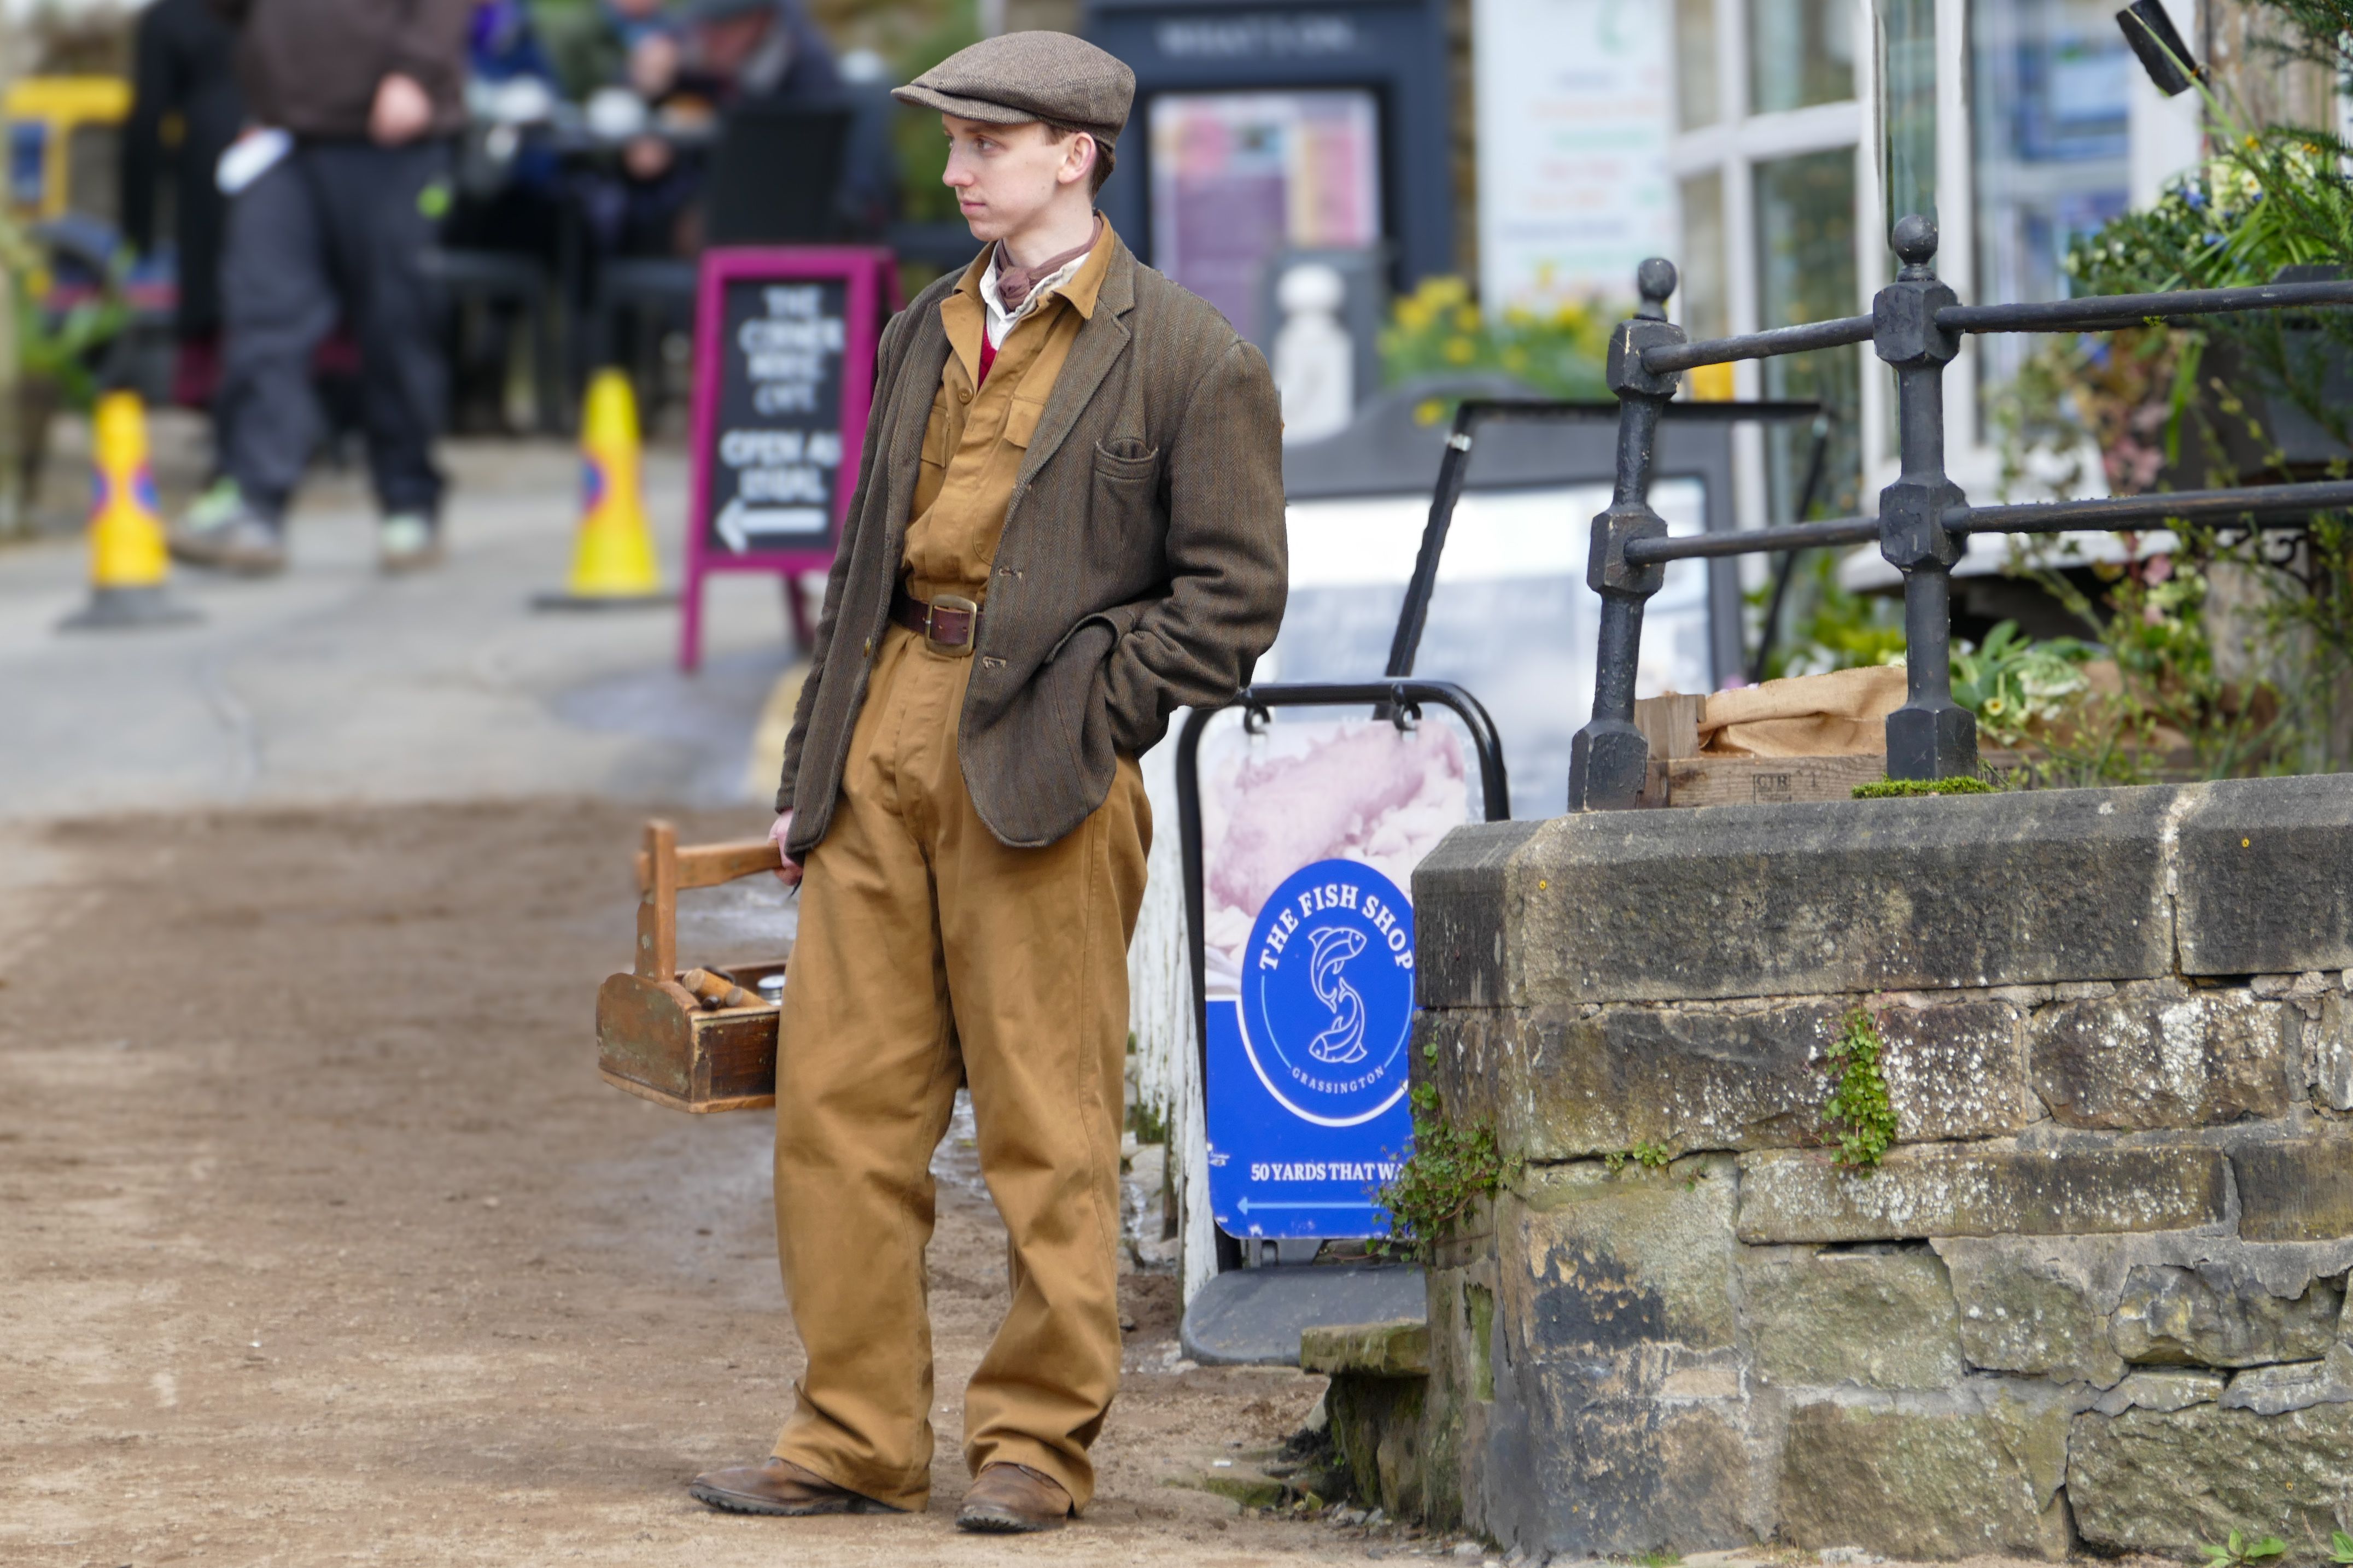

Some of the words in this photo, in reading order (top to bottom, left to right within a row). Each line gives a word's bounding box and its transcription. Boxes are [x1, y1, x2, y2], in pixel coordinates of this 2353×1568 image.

[764, 285, 821, 317] THE
[720, 430, 803, 466] OPEN
[806, 431, 843, 467] AS
[1259, 909, 1299, 970] THE
[1298, 884, 1359, 918] FISH
[1362, 895, 1414, 969] SHOP
[1292, 1066, 1384, 1094] GRASSINGTON
[1251, 1163, 1270, 1181] 50
[1271, 1163, 1326, 1181] YARDS
[1328, 1163, 1375, 1181] THAT
